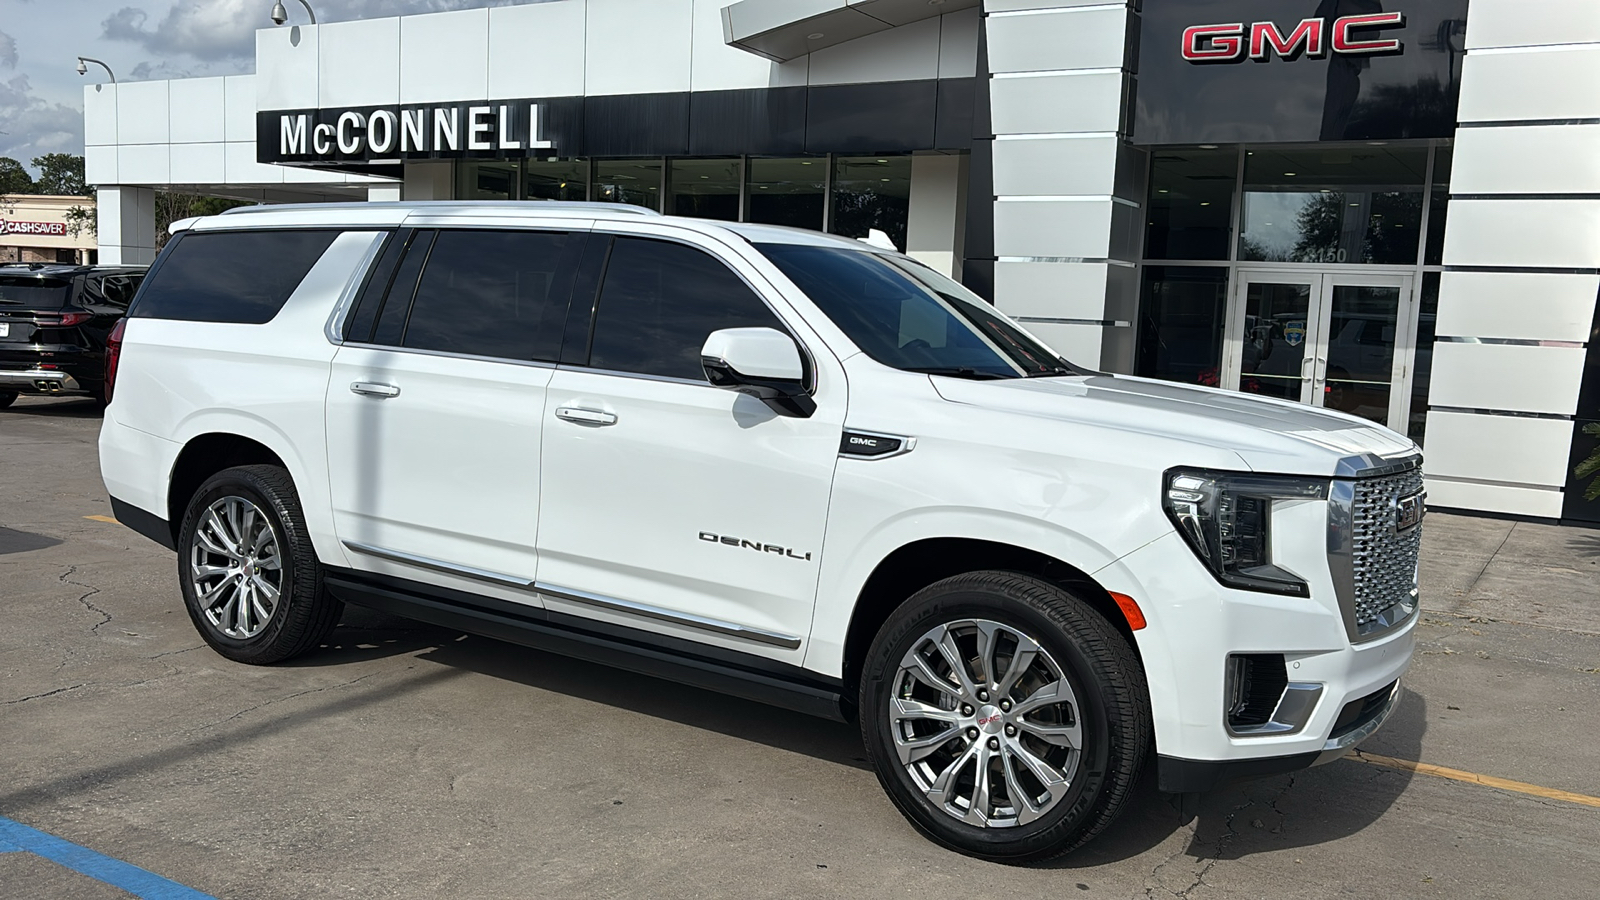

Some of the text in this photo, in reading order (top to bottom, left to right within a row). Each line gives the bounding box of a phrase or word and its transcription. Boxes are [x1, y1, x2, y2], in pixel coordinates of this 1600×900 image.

[1181, 11, 1402, 61] GMC
[279, 103, 553, 155] McCONNELL
[7, 222, 63, 234] CASHSAVER
[849, 436, 877, 447] GMC
[698, 531, 812, 561] DENALI
[978, 714, 1001, 725] GMC
